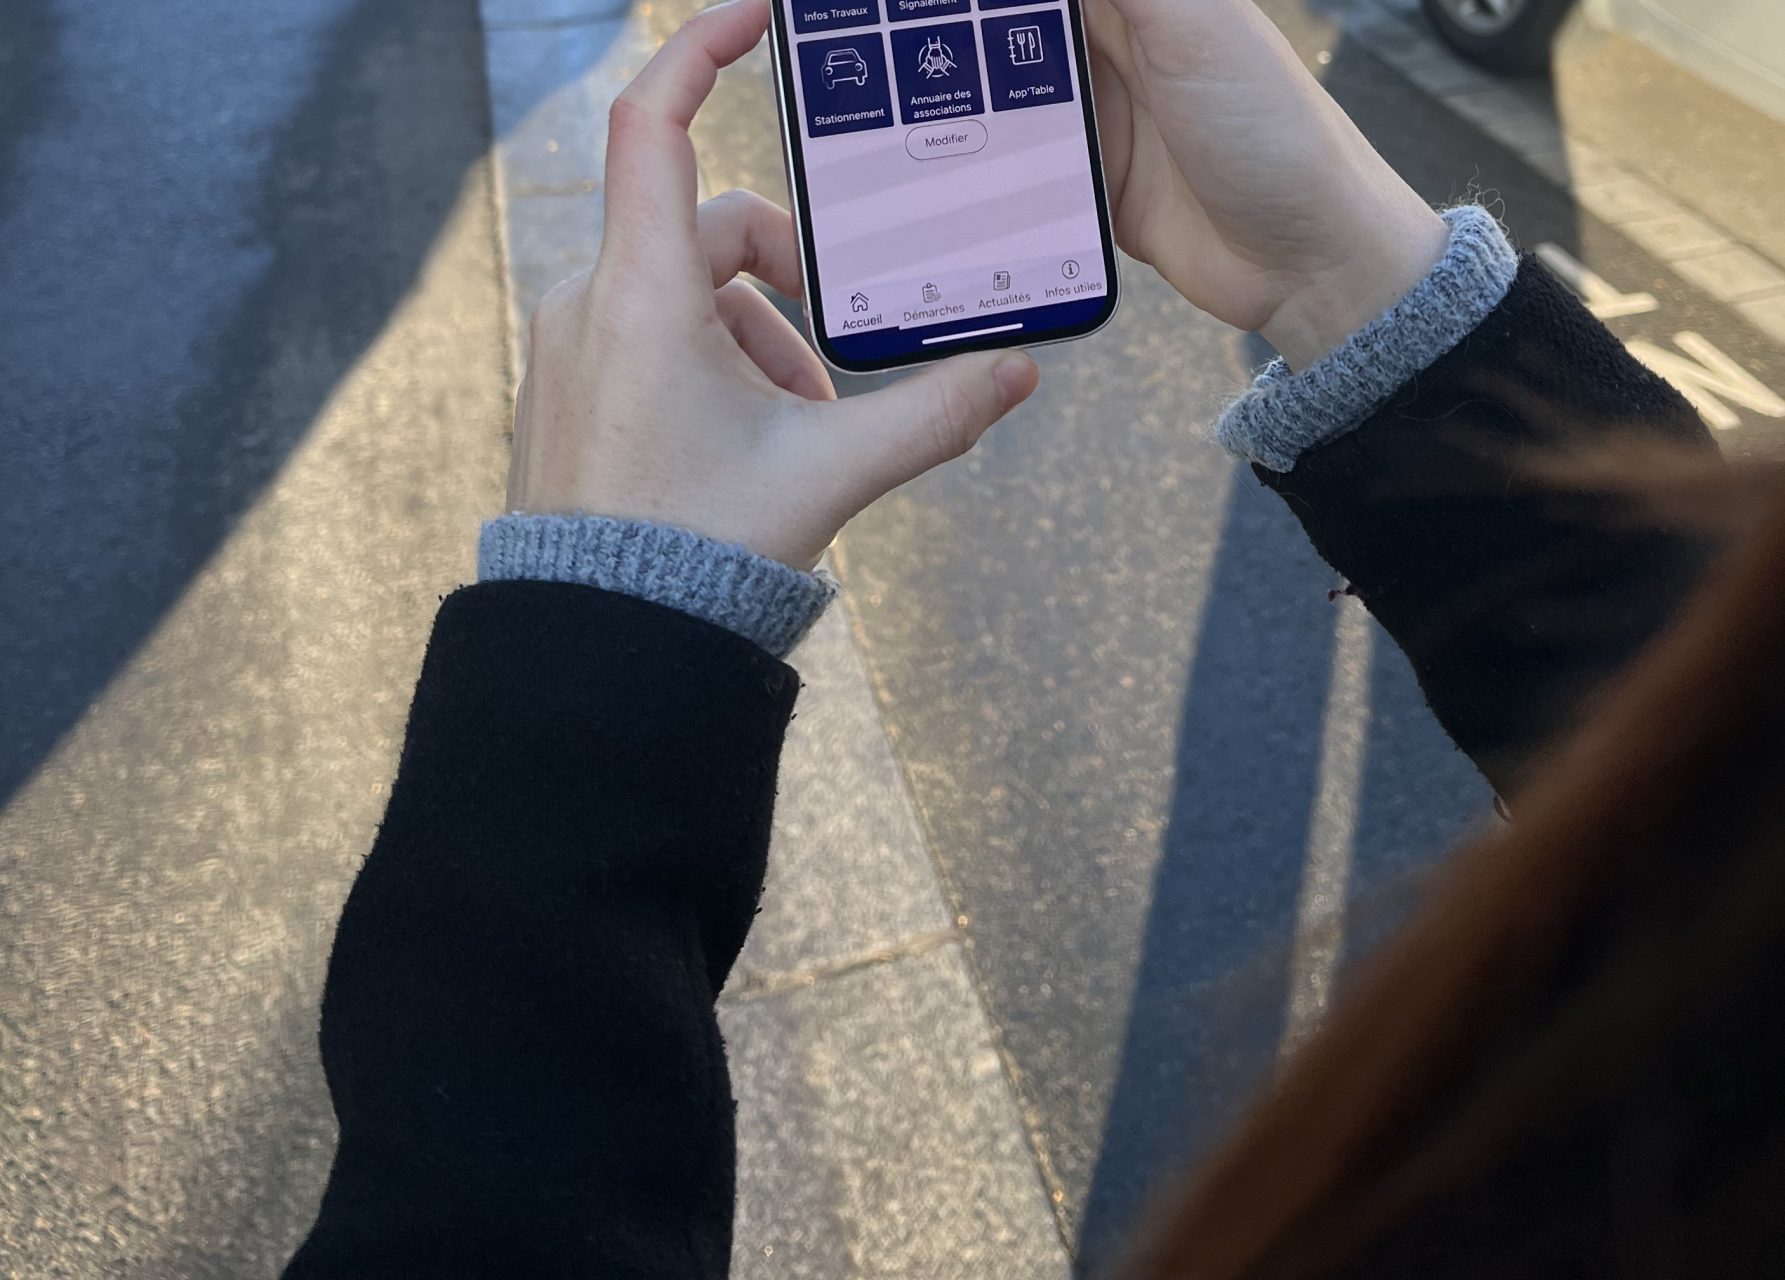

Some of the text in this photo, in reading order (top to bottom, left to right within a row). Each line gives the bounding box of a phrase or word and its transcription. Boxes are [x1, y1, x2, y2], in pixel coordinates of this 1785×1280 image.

[804, 5, 868, 22] Infos Travaux
[910, 89, 972, 106] Annuaire des
[1008, 83, 1055, 100] App'Table
[814, 107, 886, 126] Stationnement
[913, 102, 972, 120] associations
[924, 132, 969, 148] Modifier
[1045, 279, 1103, 299] Infos utiles
[978, 291, 1031, 310] Actualités
[902, 301, 965, 322] Démarches
[842, 313, 883, 330] Accueil
